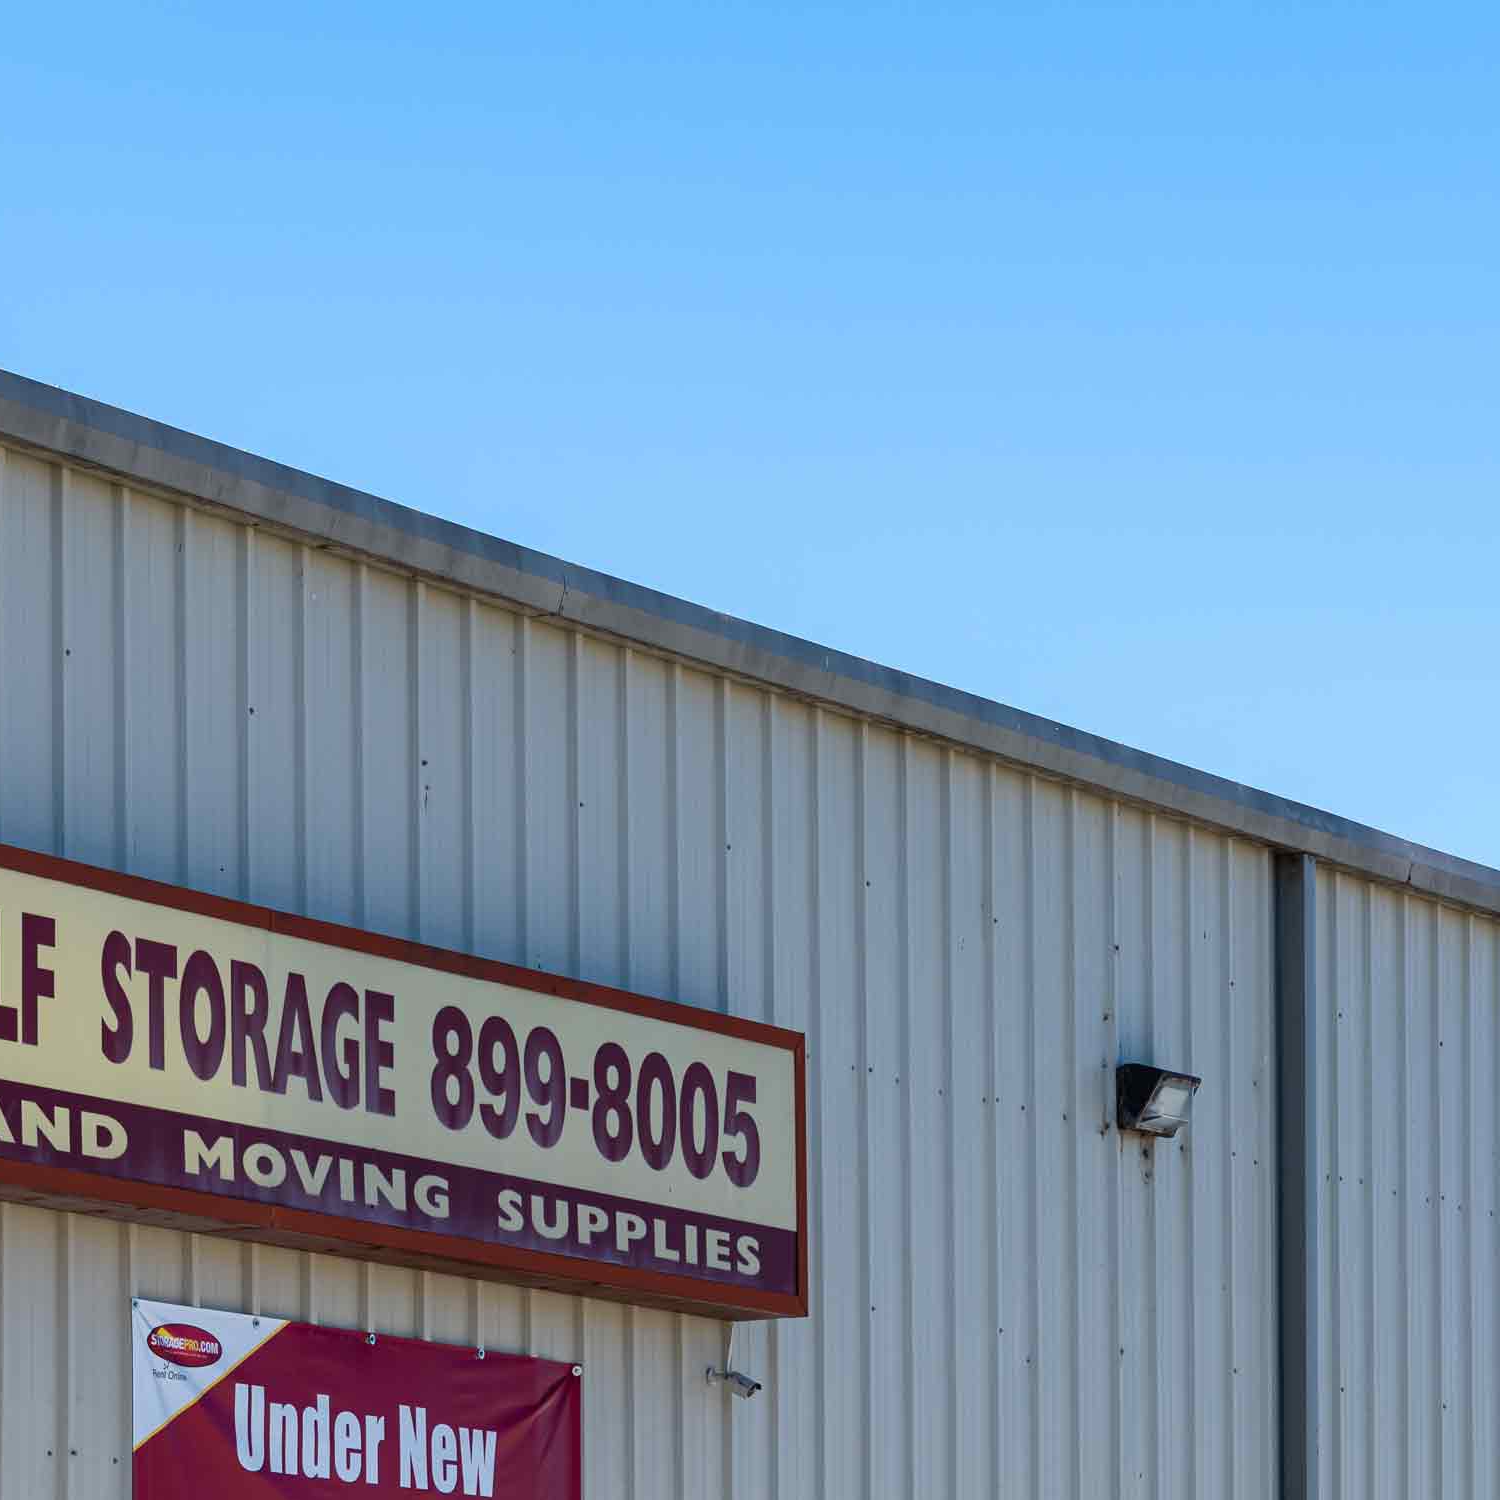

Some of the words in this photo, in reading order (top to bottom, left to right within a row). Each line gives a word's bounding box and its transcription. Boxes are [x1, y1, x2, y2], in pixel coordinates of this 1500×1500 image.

[101, 930, 396, 1118] STORAGE
[430, 1005, 762, 1189] 899-8005
[184, 1129, 451, 1219] MOVING
[498, 1190, 762, 1277] SUPPLIES
[235, 1382, 386, 1485] Under
[399, 1404, 497, 1498] New
